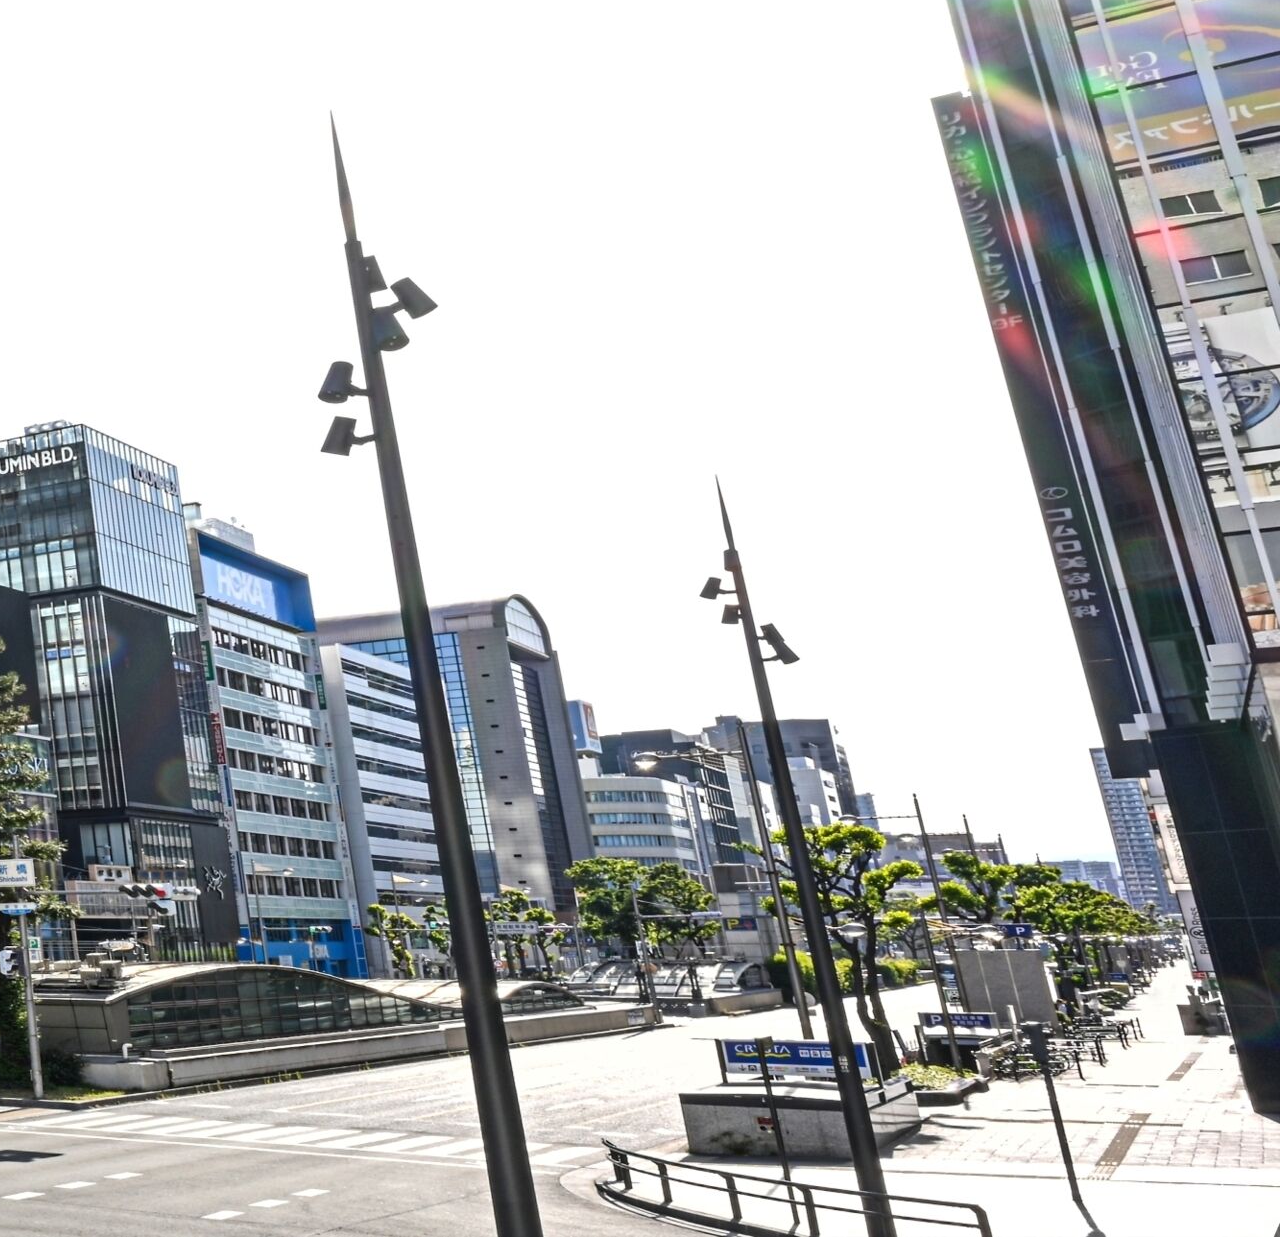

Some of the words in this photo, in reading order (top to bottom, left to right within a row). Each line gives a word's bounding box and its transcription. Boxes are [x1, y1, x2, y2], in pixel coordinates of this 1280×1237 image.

[41, 447, 78, 468] BLD.
[1045, 507, 1100, 618] コムロ美容外科
[216, 564, 266, 610] HOKA
[727, 918, 739, 930] P
[1016, 926, 1025, 935] P
[30, 938, 38, 948] P
[930, 1014, 942, 1024] P
